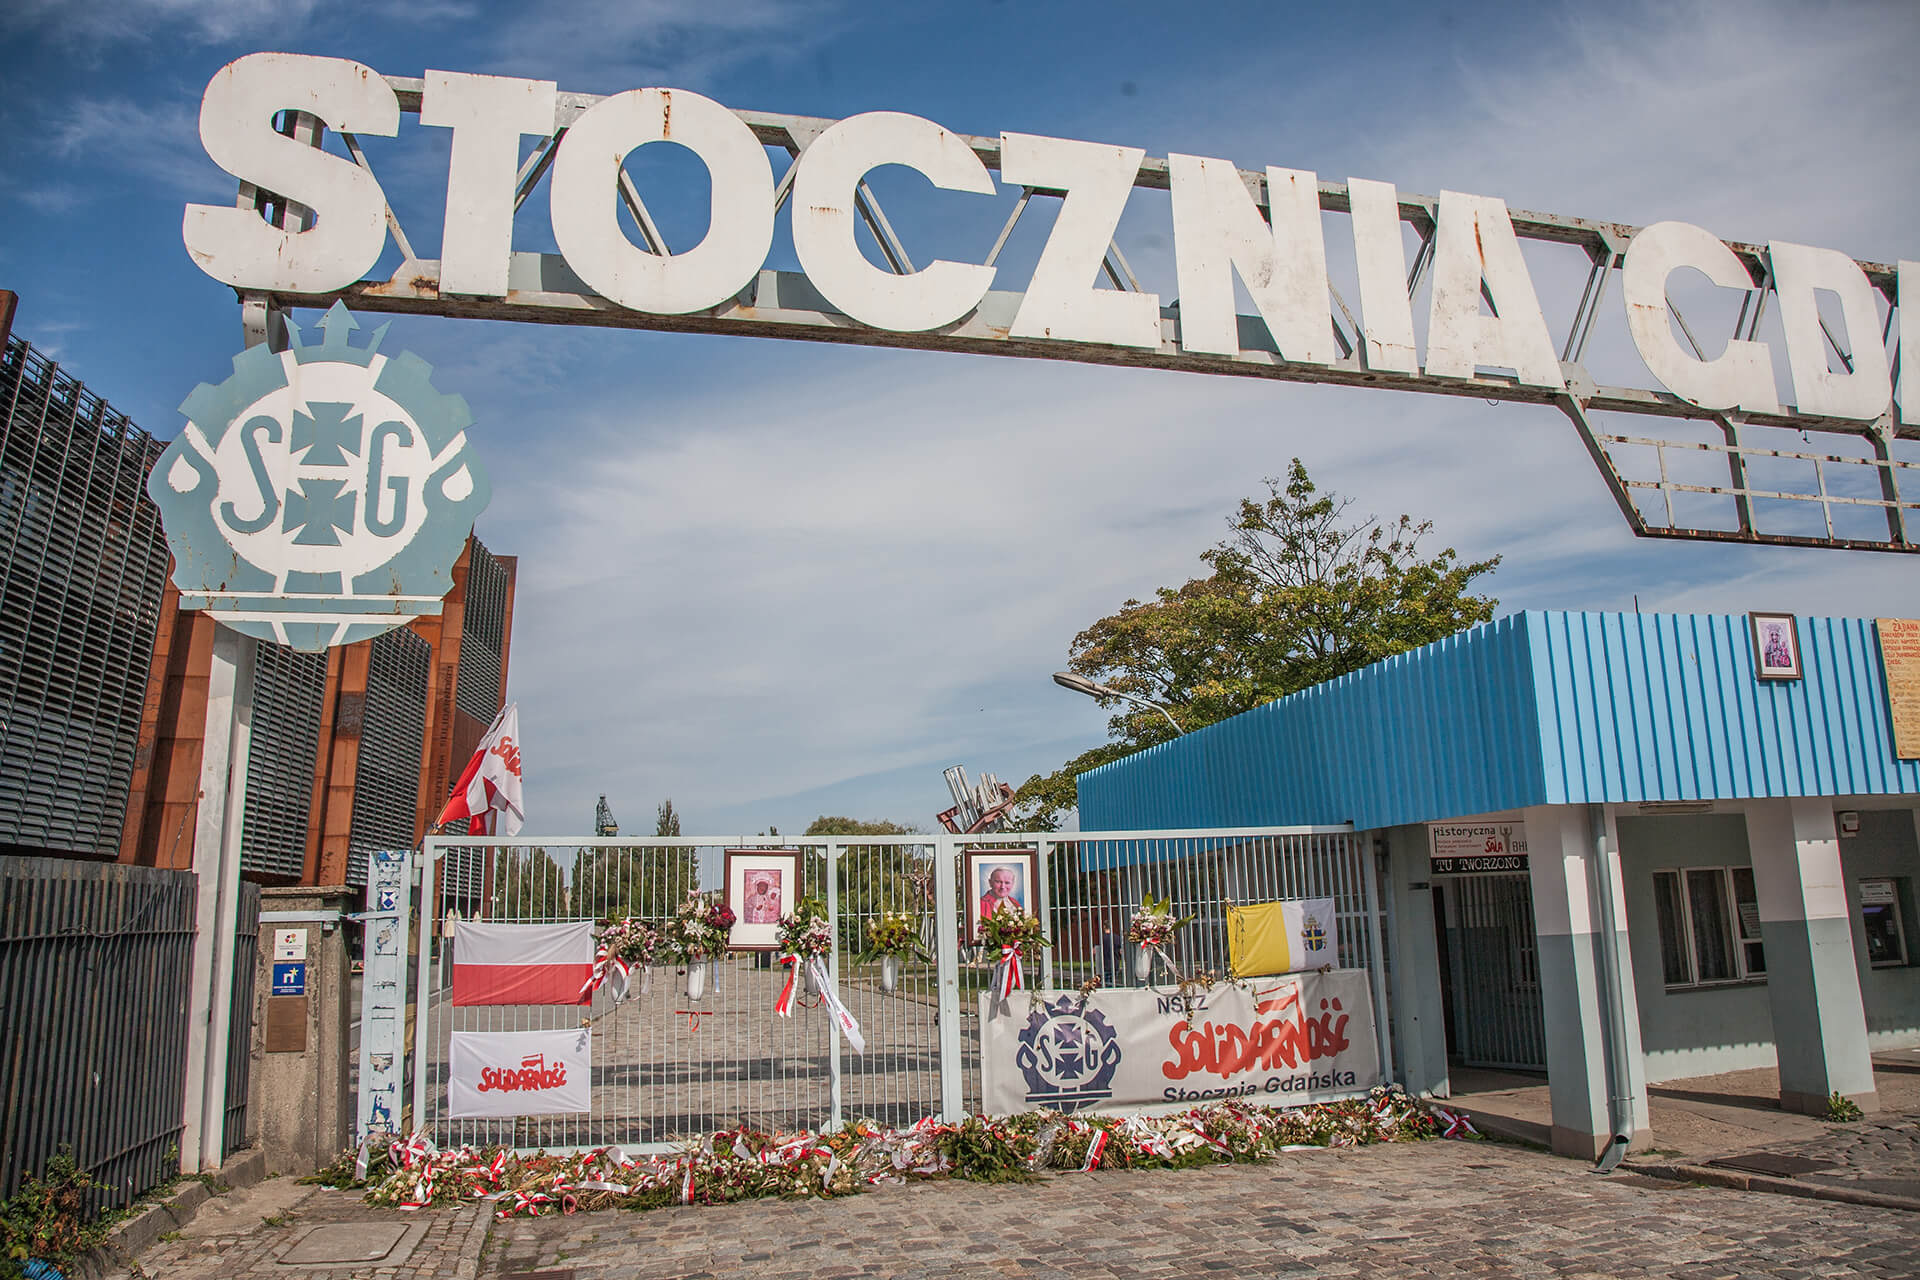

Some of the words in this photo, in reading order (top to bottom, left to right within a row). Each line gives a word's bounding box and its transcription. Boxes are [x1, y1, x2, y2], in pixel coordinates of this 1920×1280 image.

[183, 52, 1565, 388] STOCZNIA
[1623, 220, 1920, 425] GD
[220, 415, 283, 535] S
[364, 421, 413, 538] G
[1512, 840, 1527, 853] BH
[1436, 858, 1453, 872] TU
[1460, 856, 1520, 871] TWORZONO
[1163, 1081, 1257, 1103] Stocznia
[1264, 1070, 1356, 1093] Gdańska
